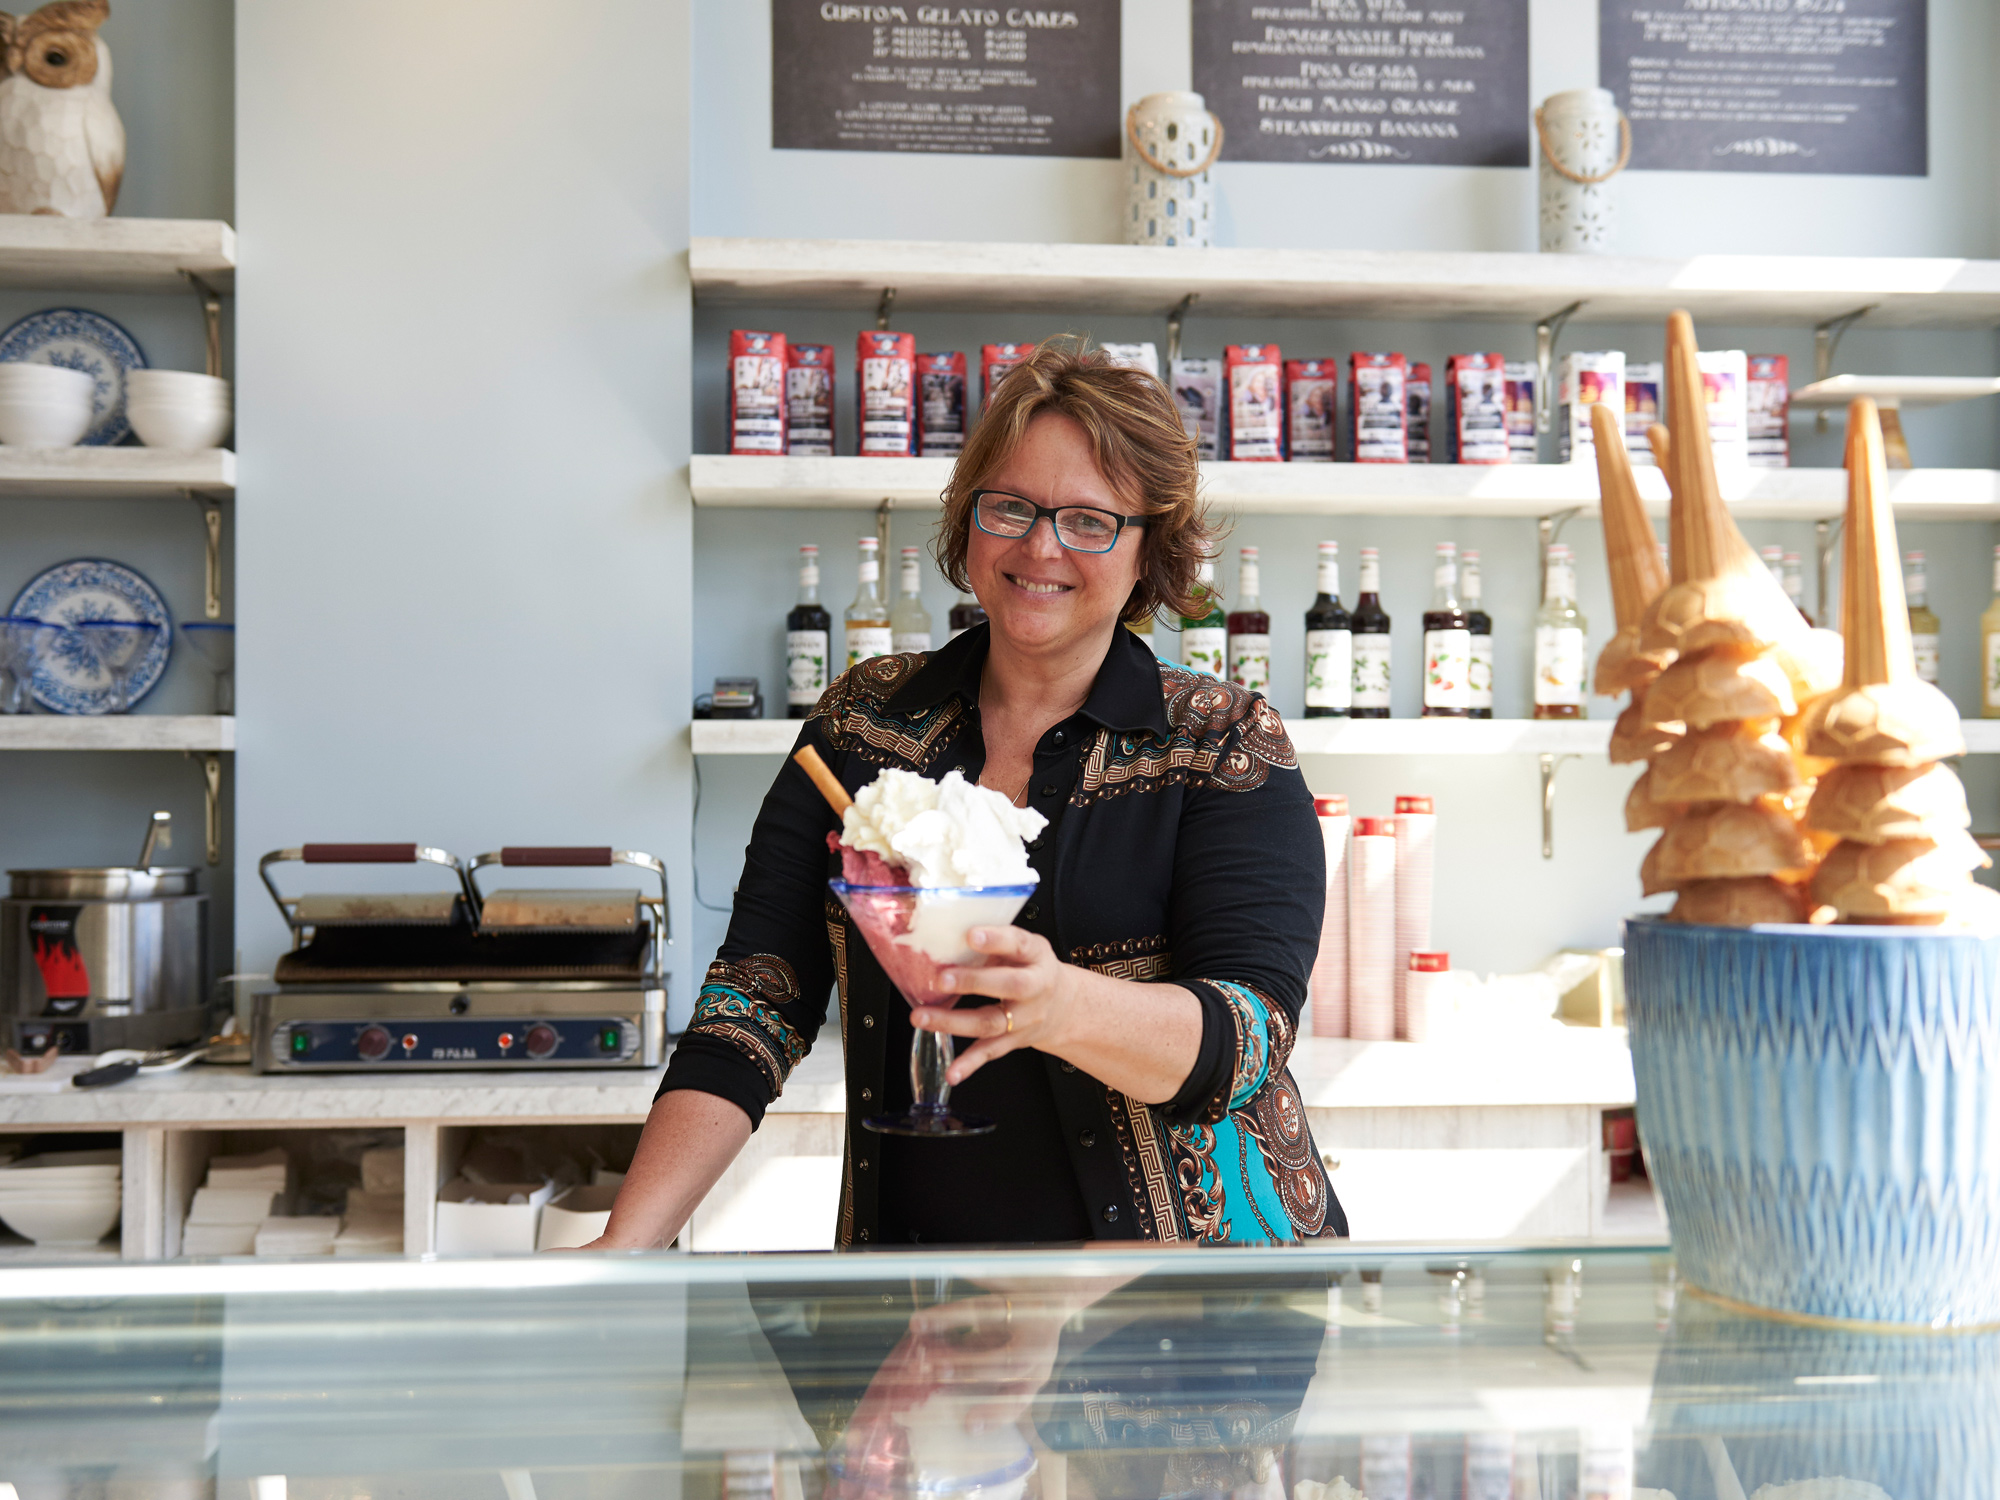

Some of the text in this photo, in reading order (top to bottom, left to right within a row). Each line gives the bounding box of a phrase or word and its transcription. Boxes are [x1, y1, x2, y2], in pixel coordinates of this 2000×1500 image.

[820, 2, 1079, 28] CUSTOM GELATO CAKES
[1258, 94, 1461, 115] PEACH MANGO ORANGE
[1259, 117, 1459, 138] STRAWBERRY BANANA
